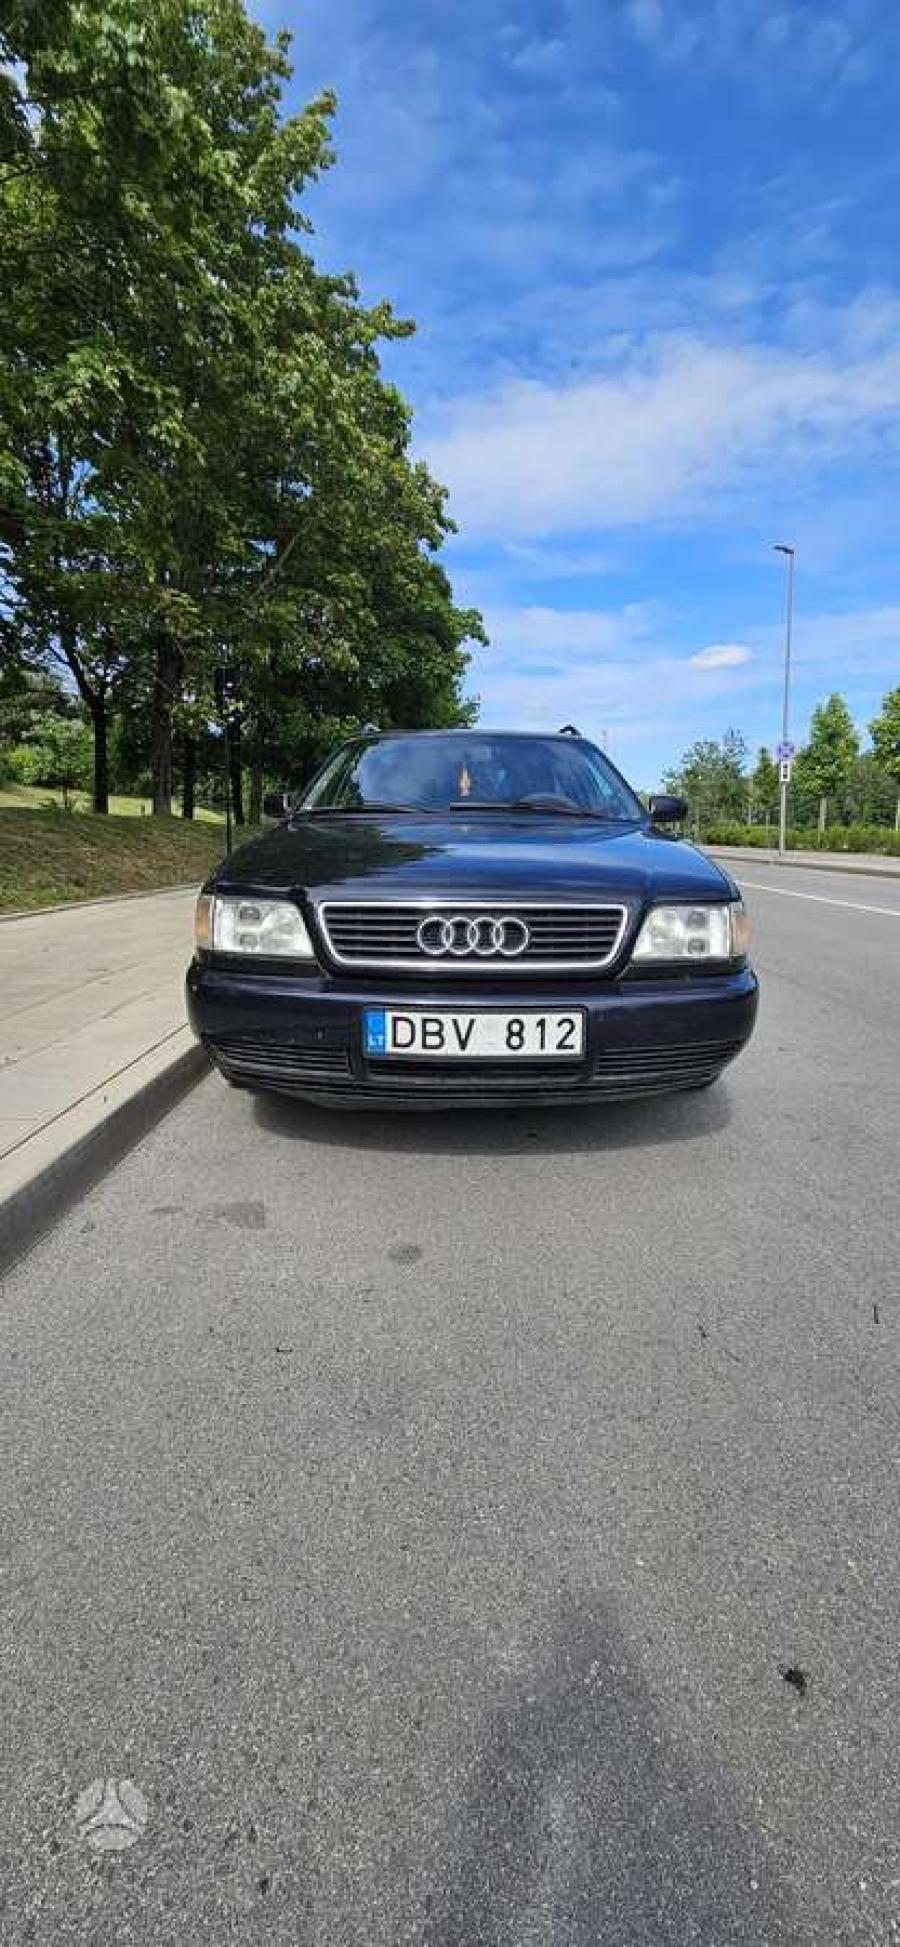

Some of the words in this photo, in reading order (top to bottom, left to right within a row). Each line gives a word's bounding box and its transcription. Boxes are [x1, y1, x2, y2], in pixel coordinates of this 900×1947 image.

[368, 1035, 384, 1046] LT
[391, 1016, 476, 1051] DBV
[505, 1018, 576, 1050] 812
